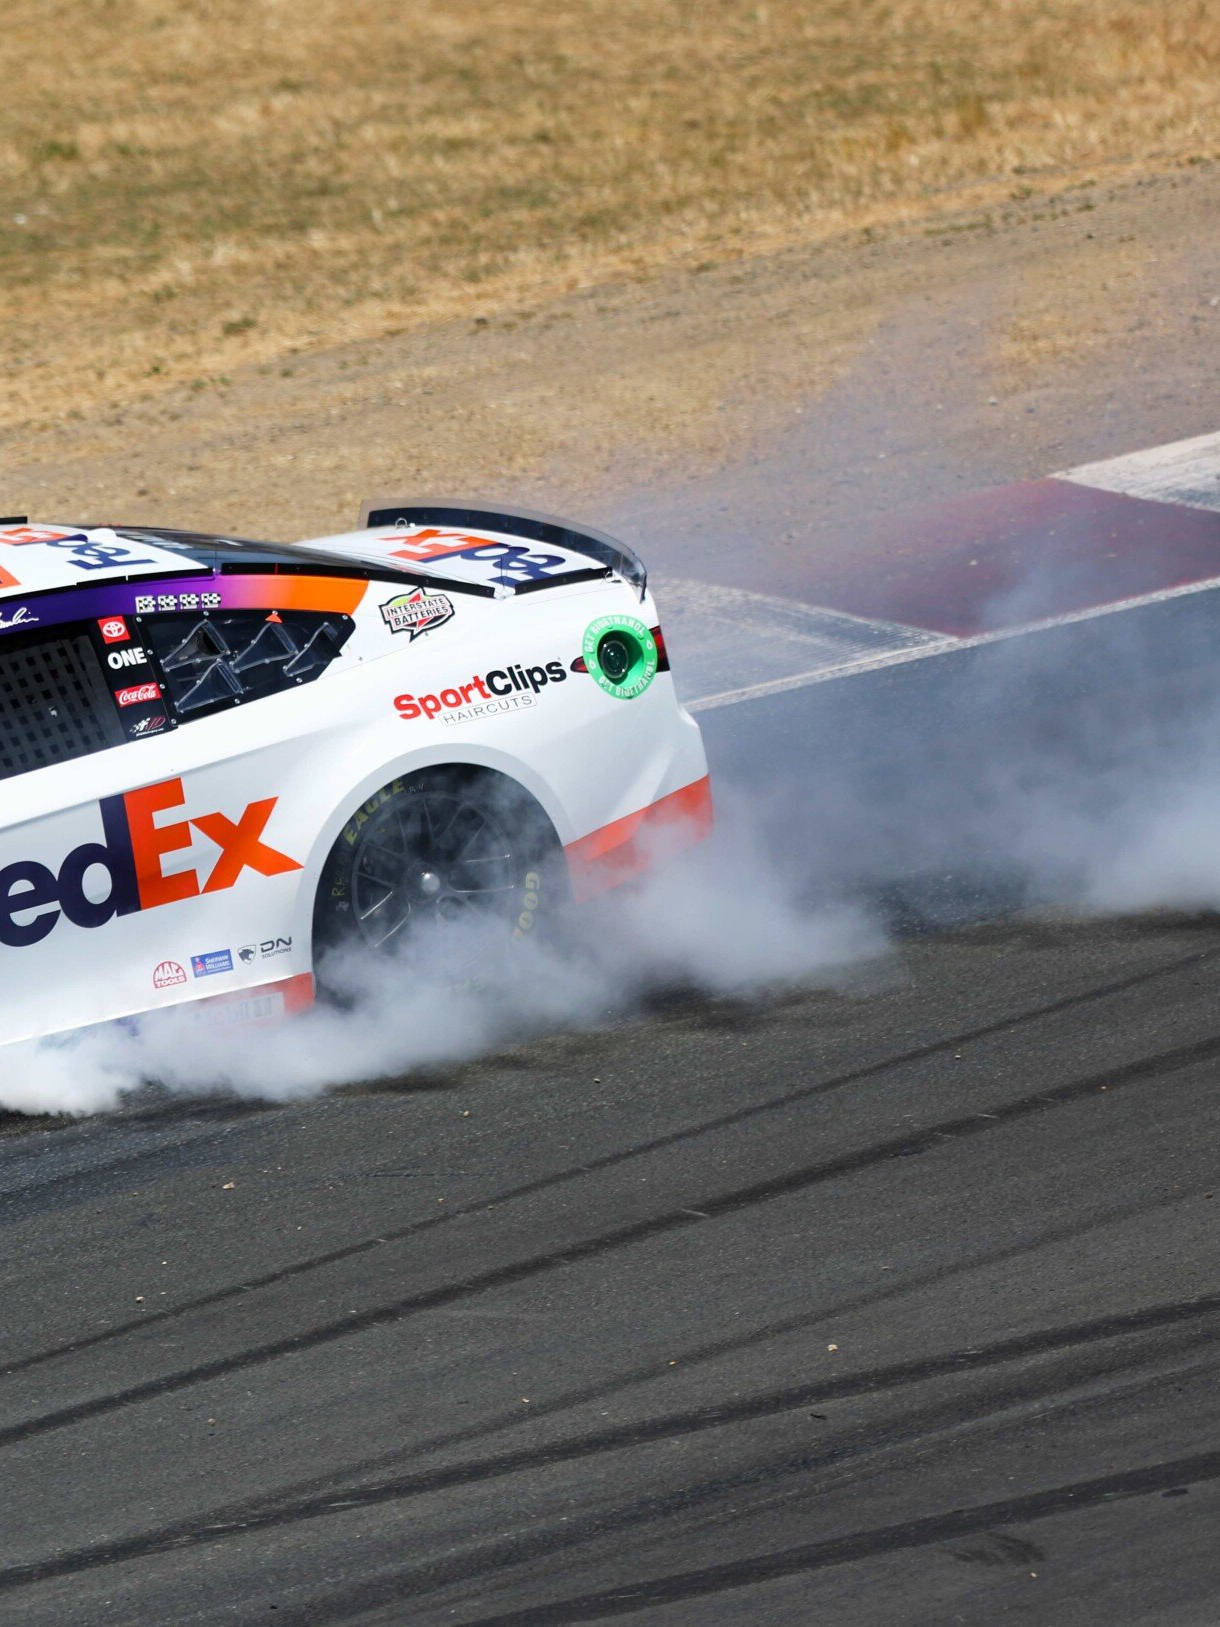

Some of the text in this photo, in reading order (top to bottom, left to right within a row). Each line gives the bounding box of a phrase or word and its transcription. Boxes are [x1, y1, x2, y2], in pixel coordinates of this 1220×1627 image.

[386, 598, 446, 617] INTERSTATE
[393, 606, 449, 626] BATTERIES
[584, 633, 595, 654] GET
[107, 646, 148, 670] ONE
[393, 660, 567, 720] SportClips
[442, 694, 535, 726] HAIRCUTS
[259, 936, 292, 953] DN
[154, 962, 182, 981] MAC
[154, 976, 186, 987] TOOLS
